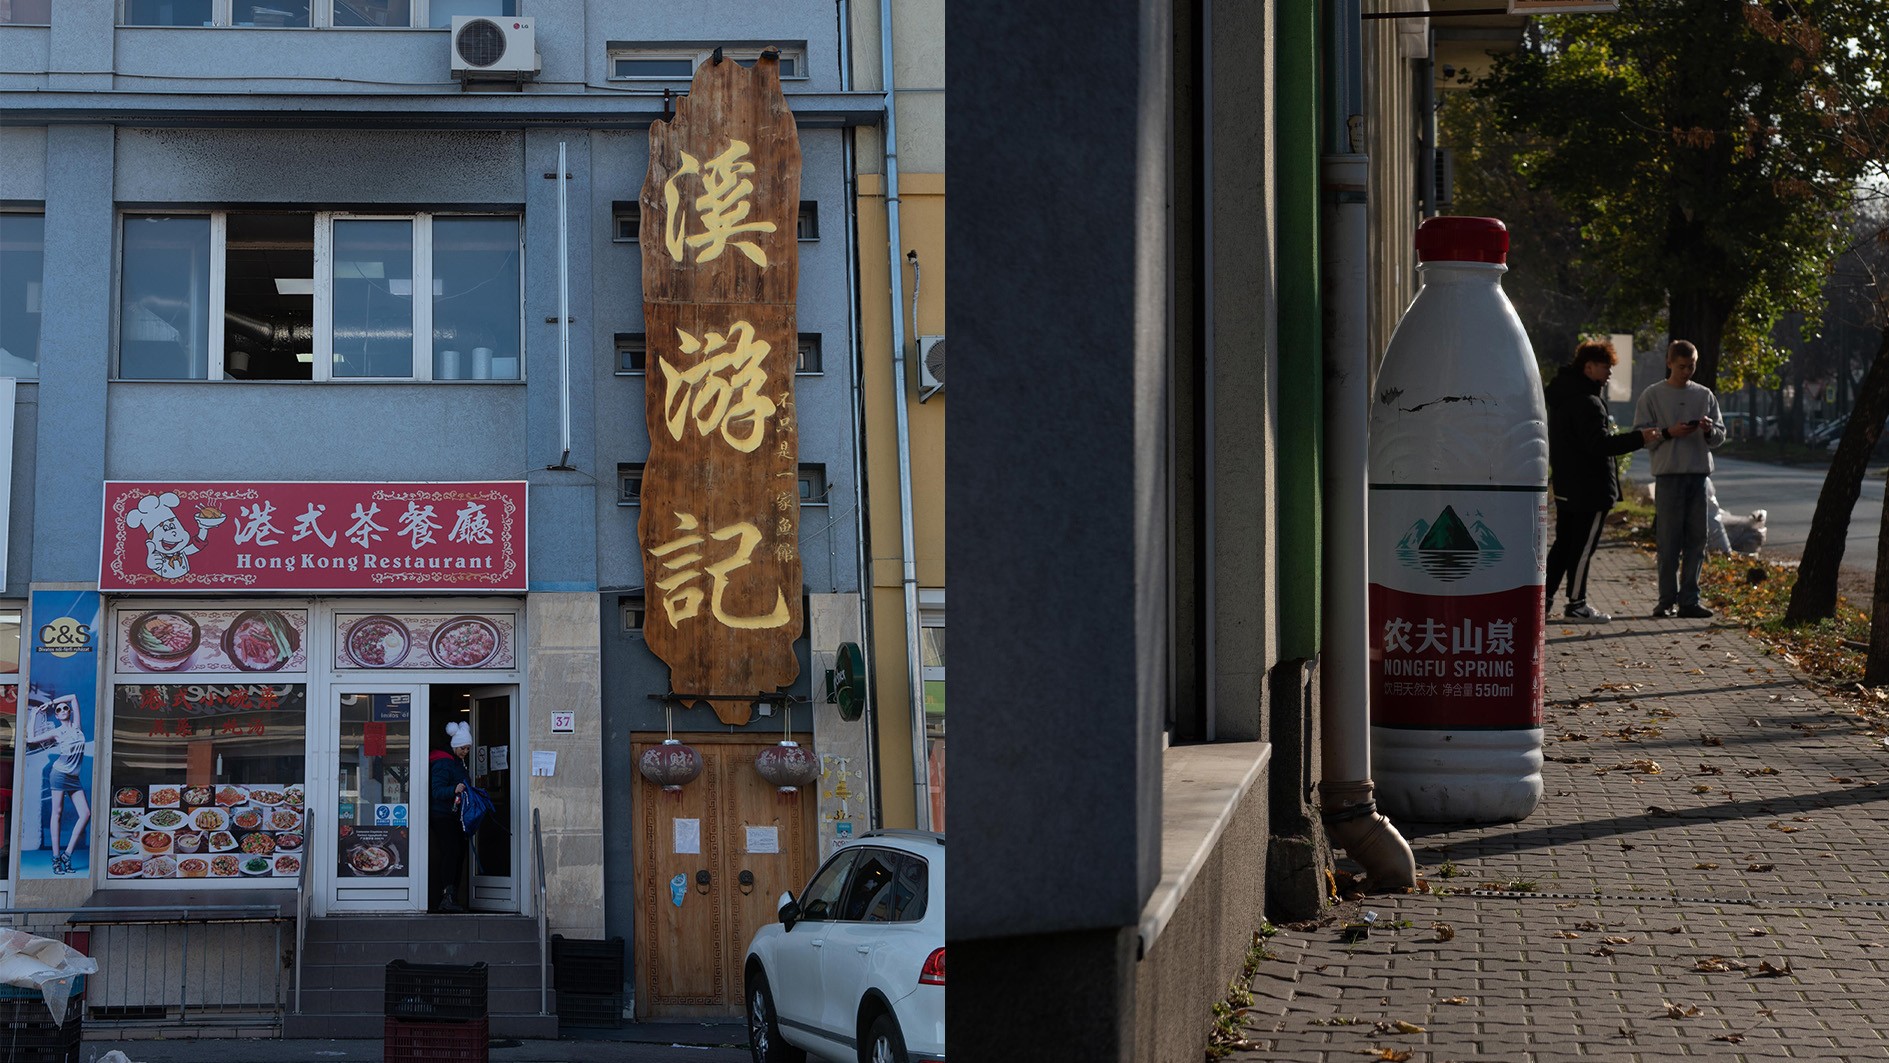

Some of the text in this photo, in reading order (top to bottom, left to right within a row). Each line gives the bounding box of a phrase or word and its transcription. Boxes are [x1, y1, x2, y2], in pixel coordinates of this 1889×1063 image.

[233, 500, 494, 550] 港式茶餐廳
[236, 553, 493, 572] Hong Kong Restaurant
[39, 624, 91, 644] C&S
[1383, 617, 1515, 655] 农夫山泉
[1384, 659, 1514, 678] NONGFU SPRING
[1383, 682, 1438, 696] 饮用天然水
[555, 716, 571, 727] 37
